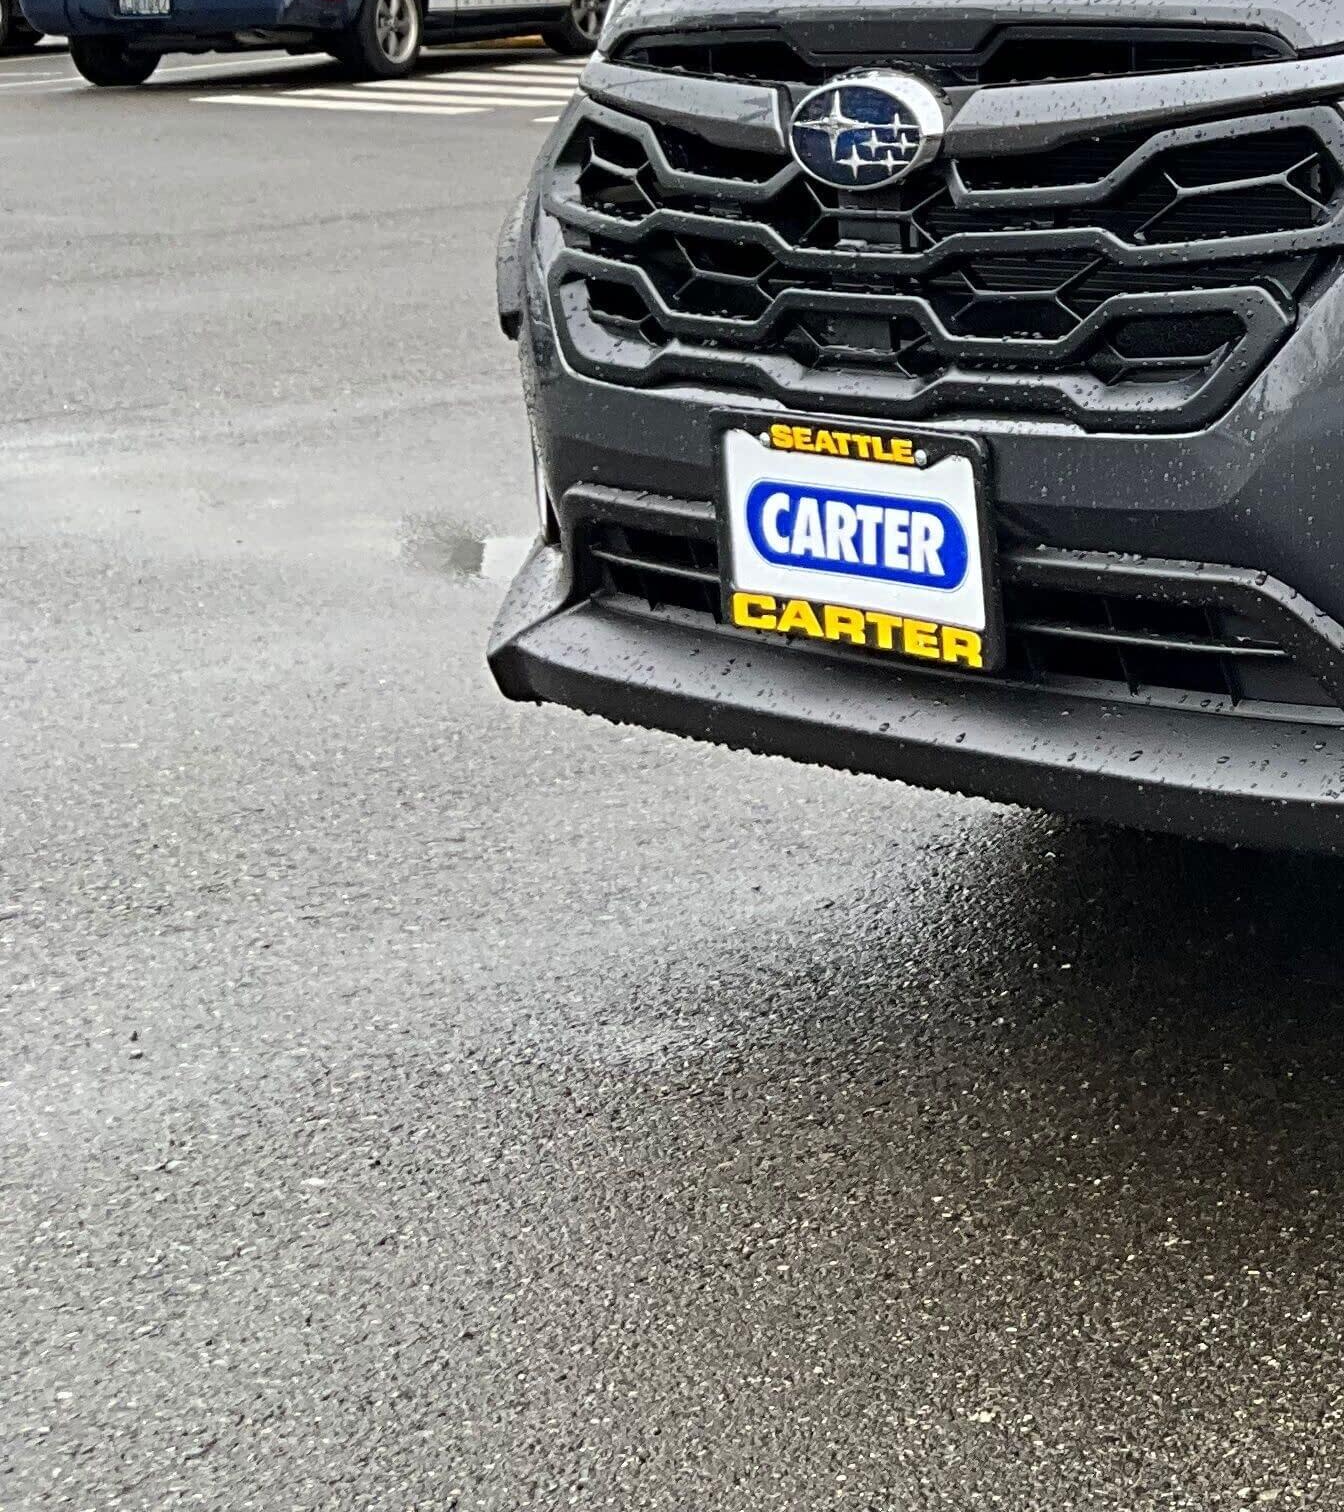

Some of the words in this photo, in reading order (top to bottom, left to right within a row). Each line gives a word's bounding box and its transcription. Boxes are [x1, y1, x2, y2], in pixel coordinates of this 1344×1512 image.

[769, 424, 915, 465] SEATTLE
[761, 491, 946, 577] CARTER
[732, 592, 984, 669] CARTER
